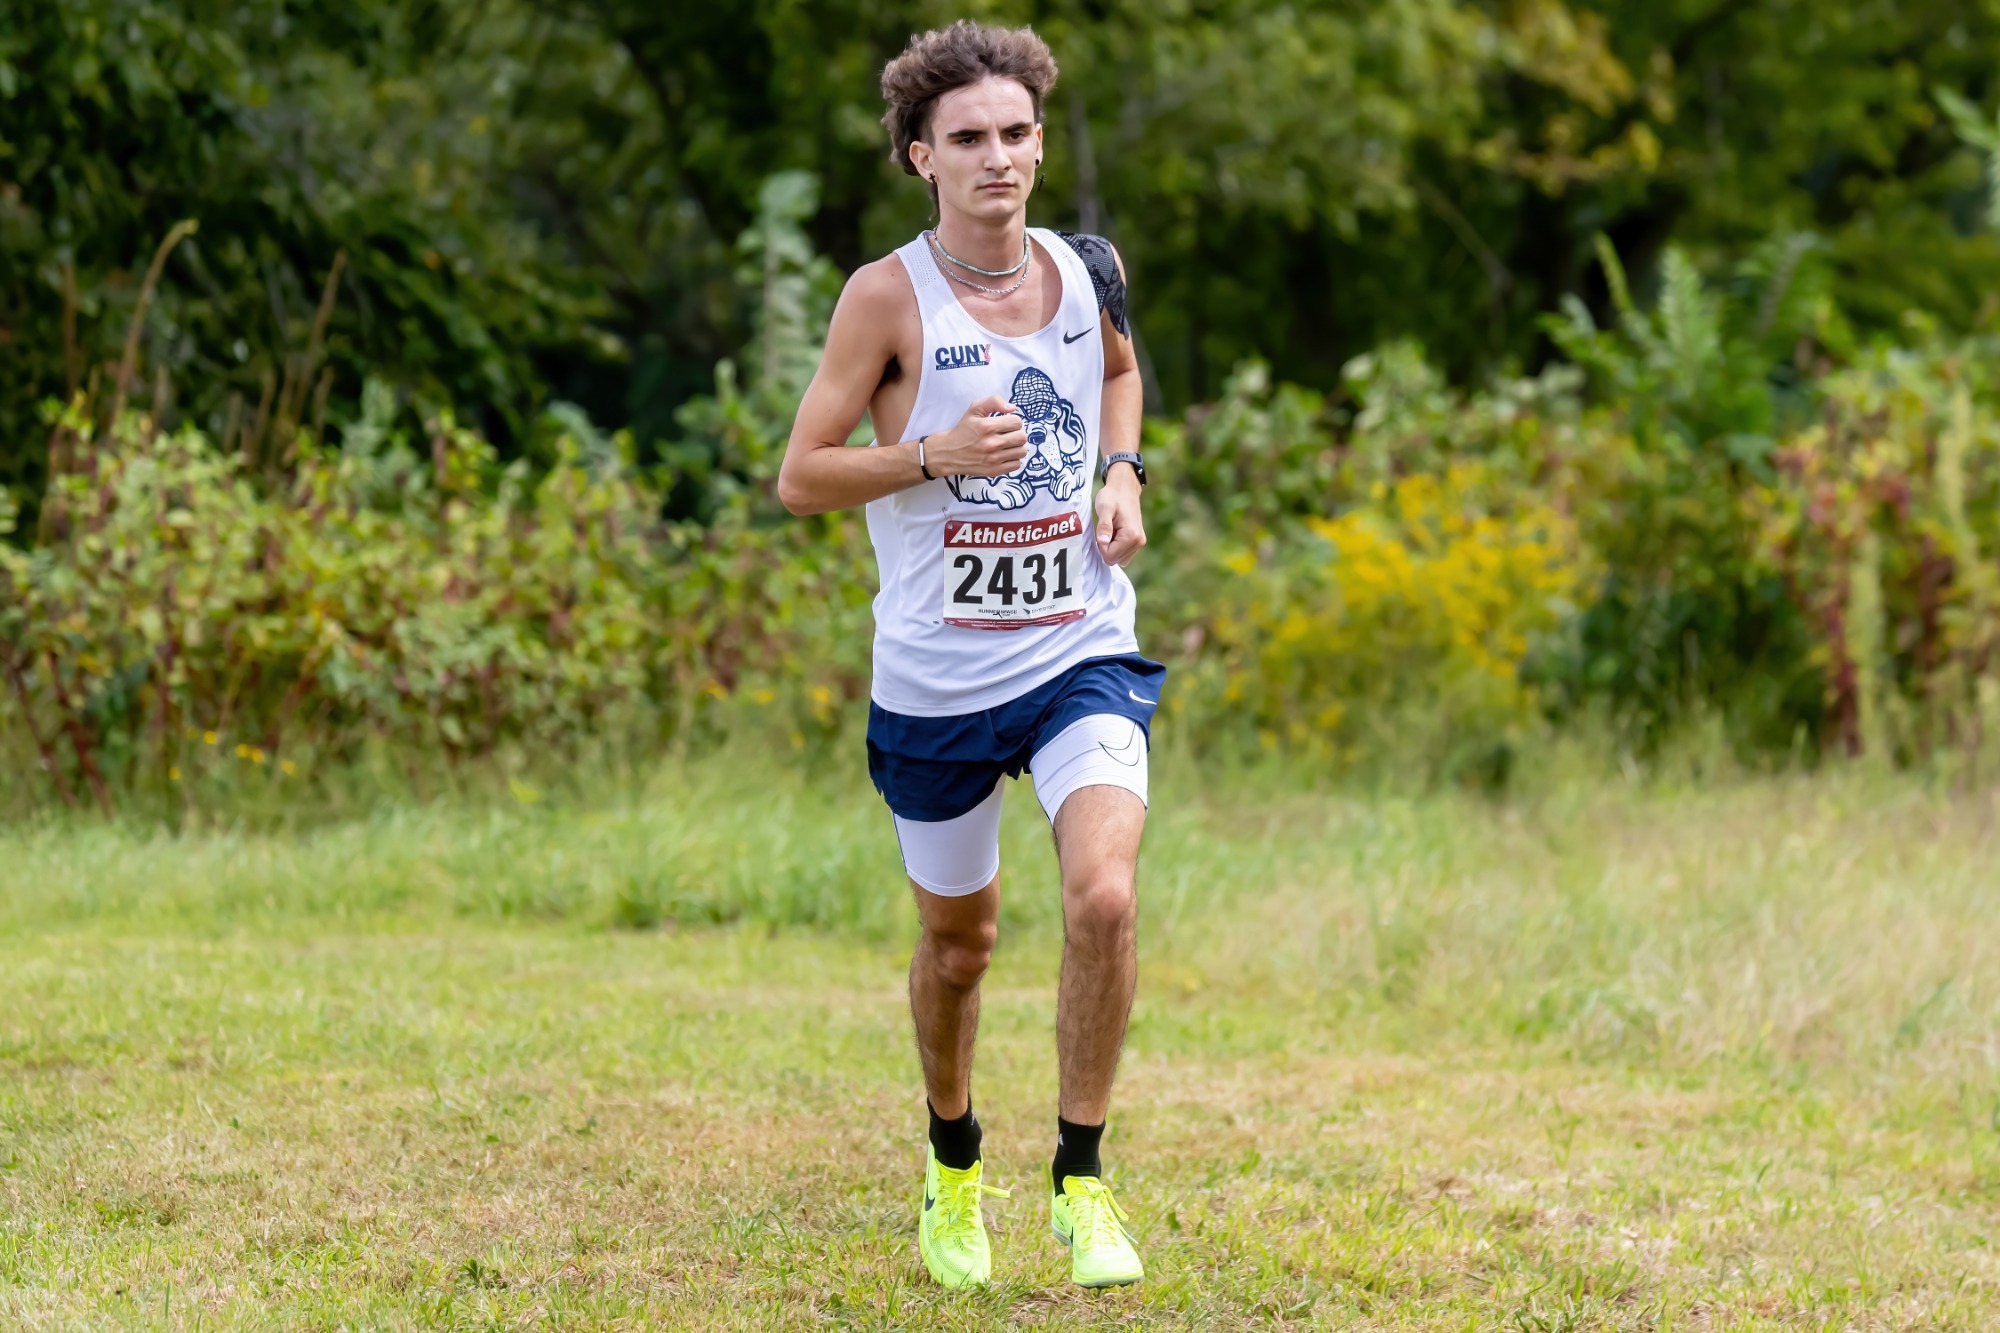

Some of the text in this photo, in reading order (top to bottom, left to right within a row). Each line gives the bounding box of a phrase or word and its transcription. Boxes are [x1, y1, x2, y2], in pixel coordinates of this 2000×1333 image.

[935, 344, 991, 366] CUNY
[950, 515, 1076, 544] Athletic.net
[953, 548, 1073, 606] 2431
